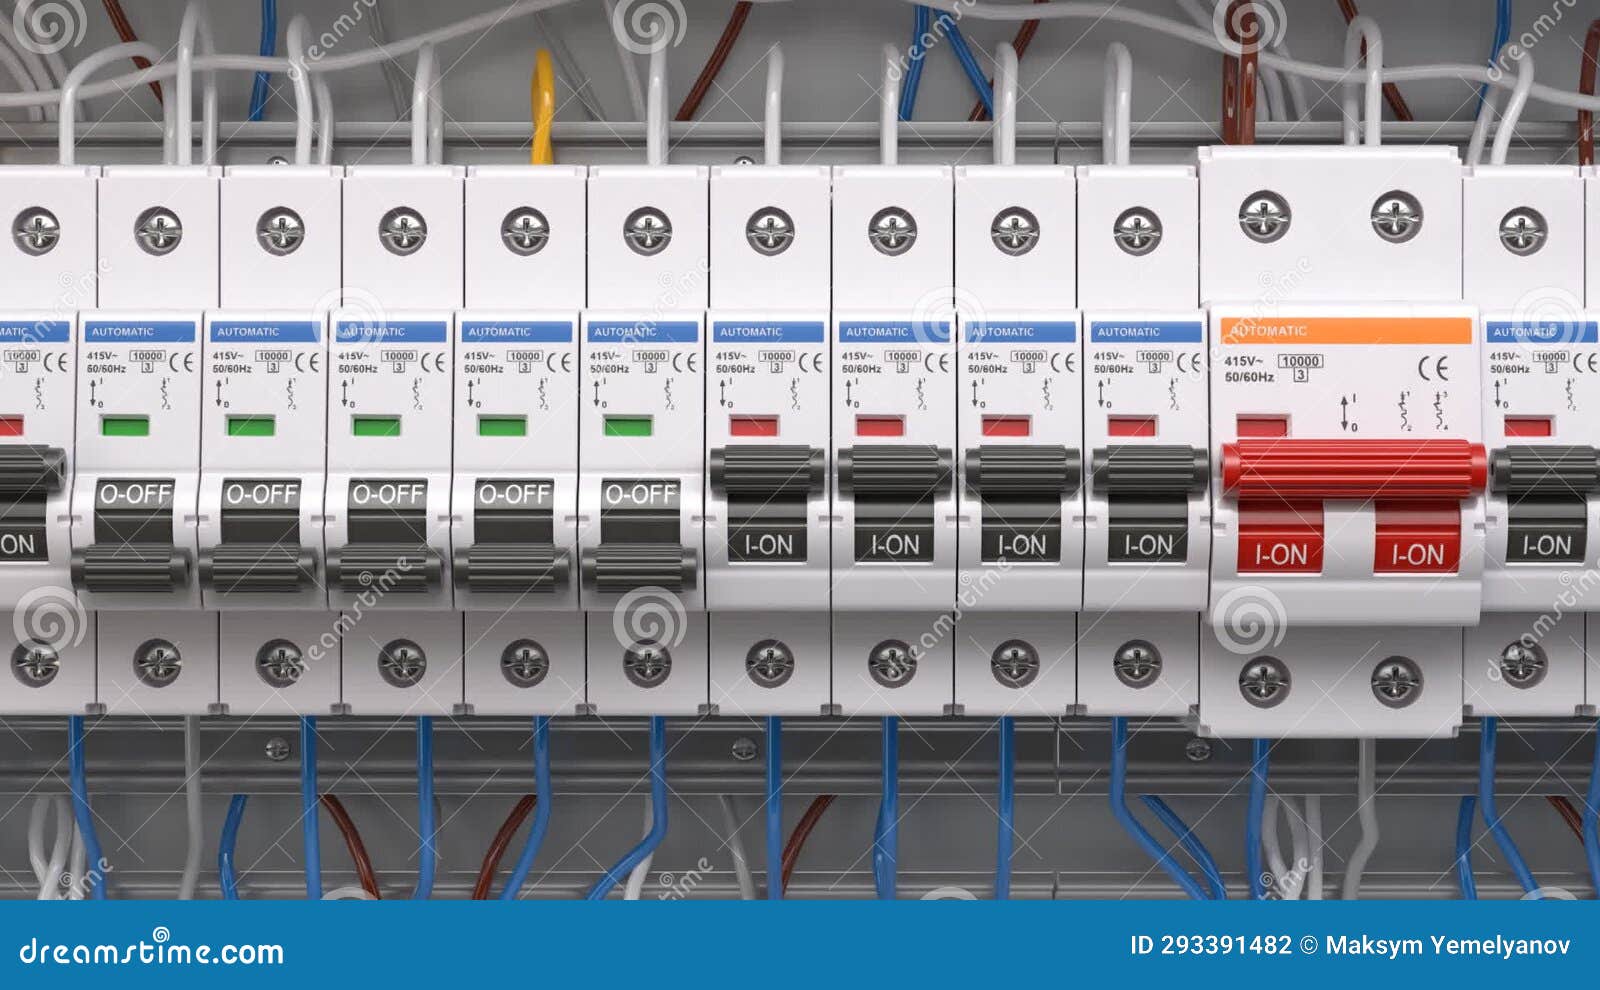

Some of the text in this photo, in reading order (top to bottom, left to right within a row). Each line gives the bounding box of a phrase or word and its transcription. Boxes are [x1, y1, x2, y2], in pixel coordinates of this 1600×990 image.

[92, 327, 154, 337] AUTOMATIC
[218, 327, 280, 337] AUTOMATIC
[344, 327, 406, 337] AUTOMATIC
[469, 327, 532, 337] AUTOMATIC
[595, 327, 658, 337] AUTOMATIC
[720, 327, 783, 337] AUTOMATIC
[846, 327, 909, 337] AUTOMATIC
[972, 327, 1035, 337] AUTOMATIC
[1098, 327, 1161, 337] AUTOMATIC
[1231, 325, 1307, 337] AUTOMATIC
[1494, 327, 1556, 337] AUTOMATIC
[133, 351, 162, 361] 10000
[259, 351, 288, 361] 10000
[385, 351, 414, 361] 10000
[510, 351, 540, 361] 10000
[636, 351, 666, 361] 10000
[762, 351, 792, 361] 10000
[888, 351, 918, 361] 10000
[1014, 351, 1044, 361] 10000
[1140, 351, 1170, 361] 10000
[1224, 355, 1263, 367] 415V~
[1536, 351, 1565, 361] 10000
[1283, 356, 1319, 367] 10000
[1225, 371, 1275, 383] 50/60Hz
[1297, 369, 1305, 380] 3
[100, 484, 173, 505] O-OFF
[226, 484, 299, 505] O-OFF
[352, 484, 425, 505] O-OFF
[478, 484, 552, 505] O-OFF
[604, 484, 679, 505] O-OFF
[0, 534, 34, 555] ON
[746, 534, 793, 555] I-ON
[872, 534, 919, 555] I-ON
[999, 534, 1046, 555] I-ON
[1126, 534, 1173, 555] I-ON
[1523, 534, 1572, 556] I-ON
[1255, 543, 1308, 566] I-ON
[1392, 543, 1444, 566] I-ON
